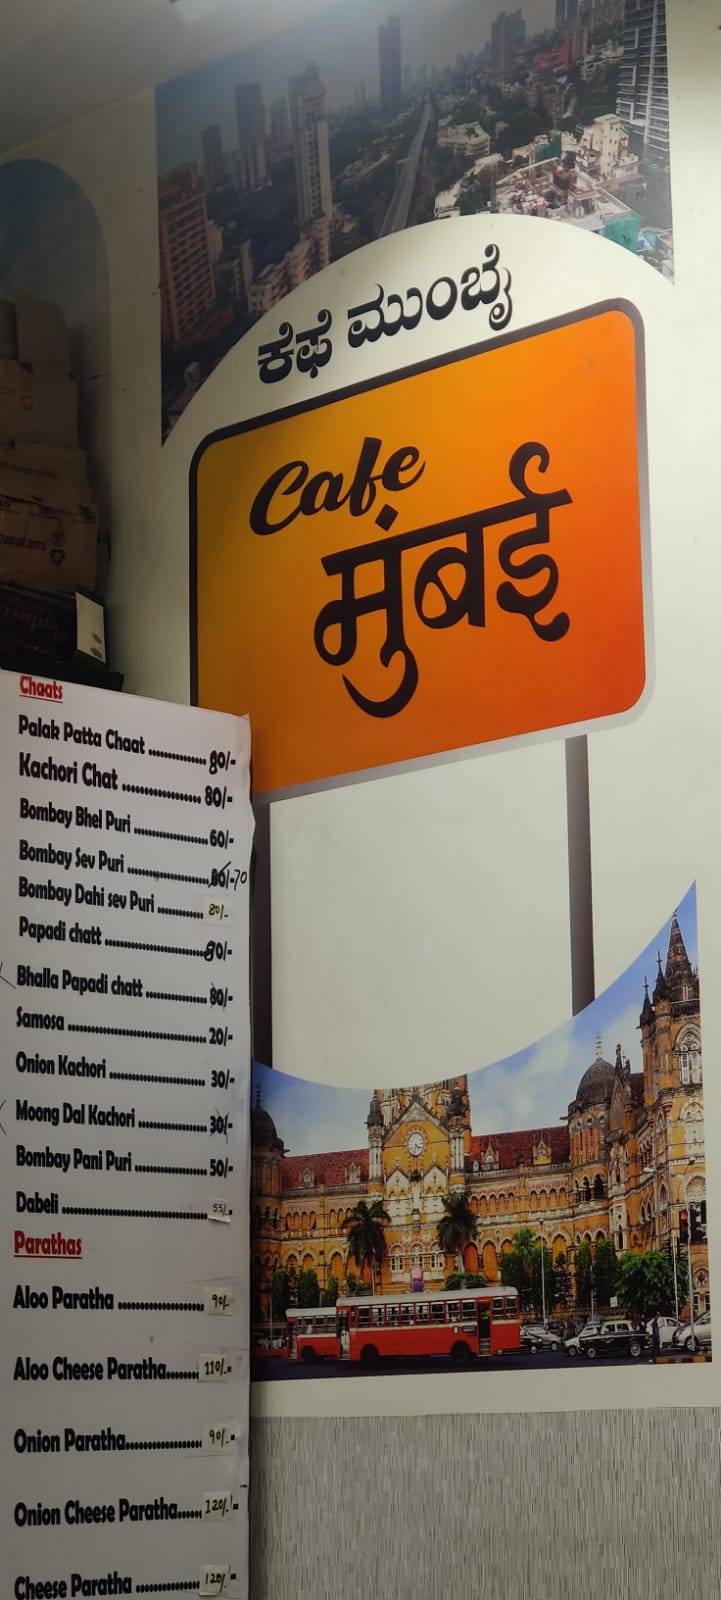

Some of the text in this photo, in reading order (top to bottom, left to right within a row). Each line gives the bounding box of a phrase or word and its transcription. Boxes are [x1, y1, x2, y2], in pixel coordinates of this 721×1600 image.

[257, 243, 513, 384] ಕೆಫೆ ಮುಂಬೈ
[249, 436, 426, 536] Cafe
[313, 441, 573, 719] मुंबई
[19, 675, 63, 700] Chaats
[18, 714, 60, 740] Palak
[63, 721, 101, 747] Patta
[105, 729, 145, 755] Chaat
[19, 752, 233, 809] Kachori Chat 80/-
[19, 798, 234, 849] Bombay Bhel Puri 60/-
[19, 839, 72, 870] Bombay
[75, 847, 95, 869] Sev
[99, 850, 124, 873] Puri
[18, 876, 229, 920] Bombay Dahi sev Puri 80/-
[19, 916, 66, 943] Papadi
[68, 924, 102, 946] chatt
[17, 964, 59, 989] Bhalla
[62, 969, 108, 996] Papadi
[111, 975, 143, 997] chatt
[16, 1006, 233, 1047] Samosa 20/-
[15, 1051, 235, 1089] Onion Kachori 30/-
[15, 1099, 60, 1126] Moong
[63, 1102, 85, 1125] Dal
[88, 1104, 136, 1128] Kachori
[15, 1145, 233, 1178] Bombay Pani Puri 50/-
[16, 1191, 58, 1214] Dabeli
[14, 1230, 82, 1256] Parathas
[13, 1285, 48, 1310] Aloo
[52, 1285, 114, 1310] Paratha
[13, 1356, 49, 1381] Aloo
[52, 1358, 104, 1381] Cheese
[107, 1357, 167, 1381] Paratha
[13, 1428, 60, 1453] Onion
[64, 1427, 126, 1453] Paratha
[14, 1502, 61, 1527] Onion
[64, 1499, 116, 1524] Cheese
[119, 1497, 178, 1523] Paratha
[14, 1576, 67, 1600] Cheese
[70, 1571, 132, 1597] Paratha
